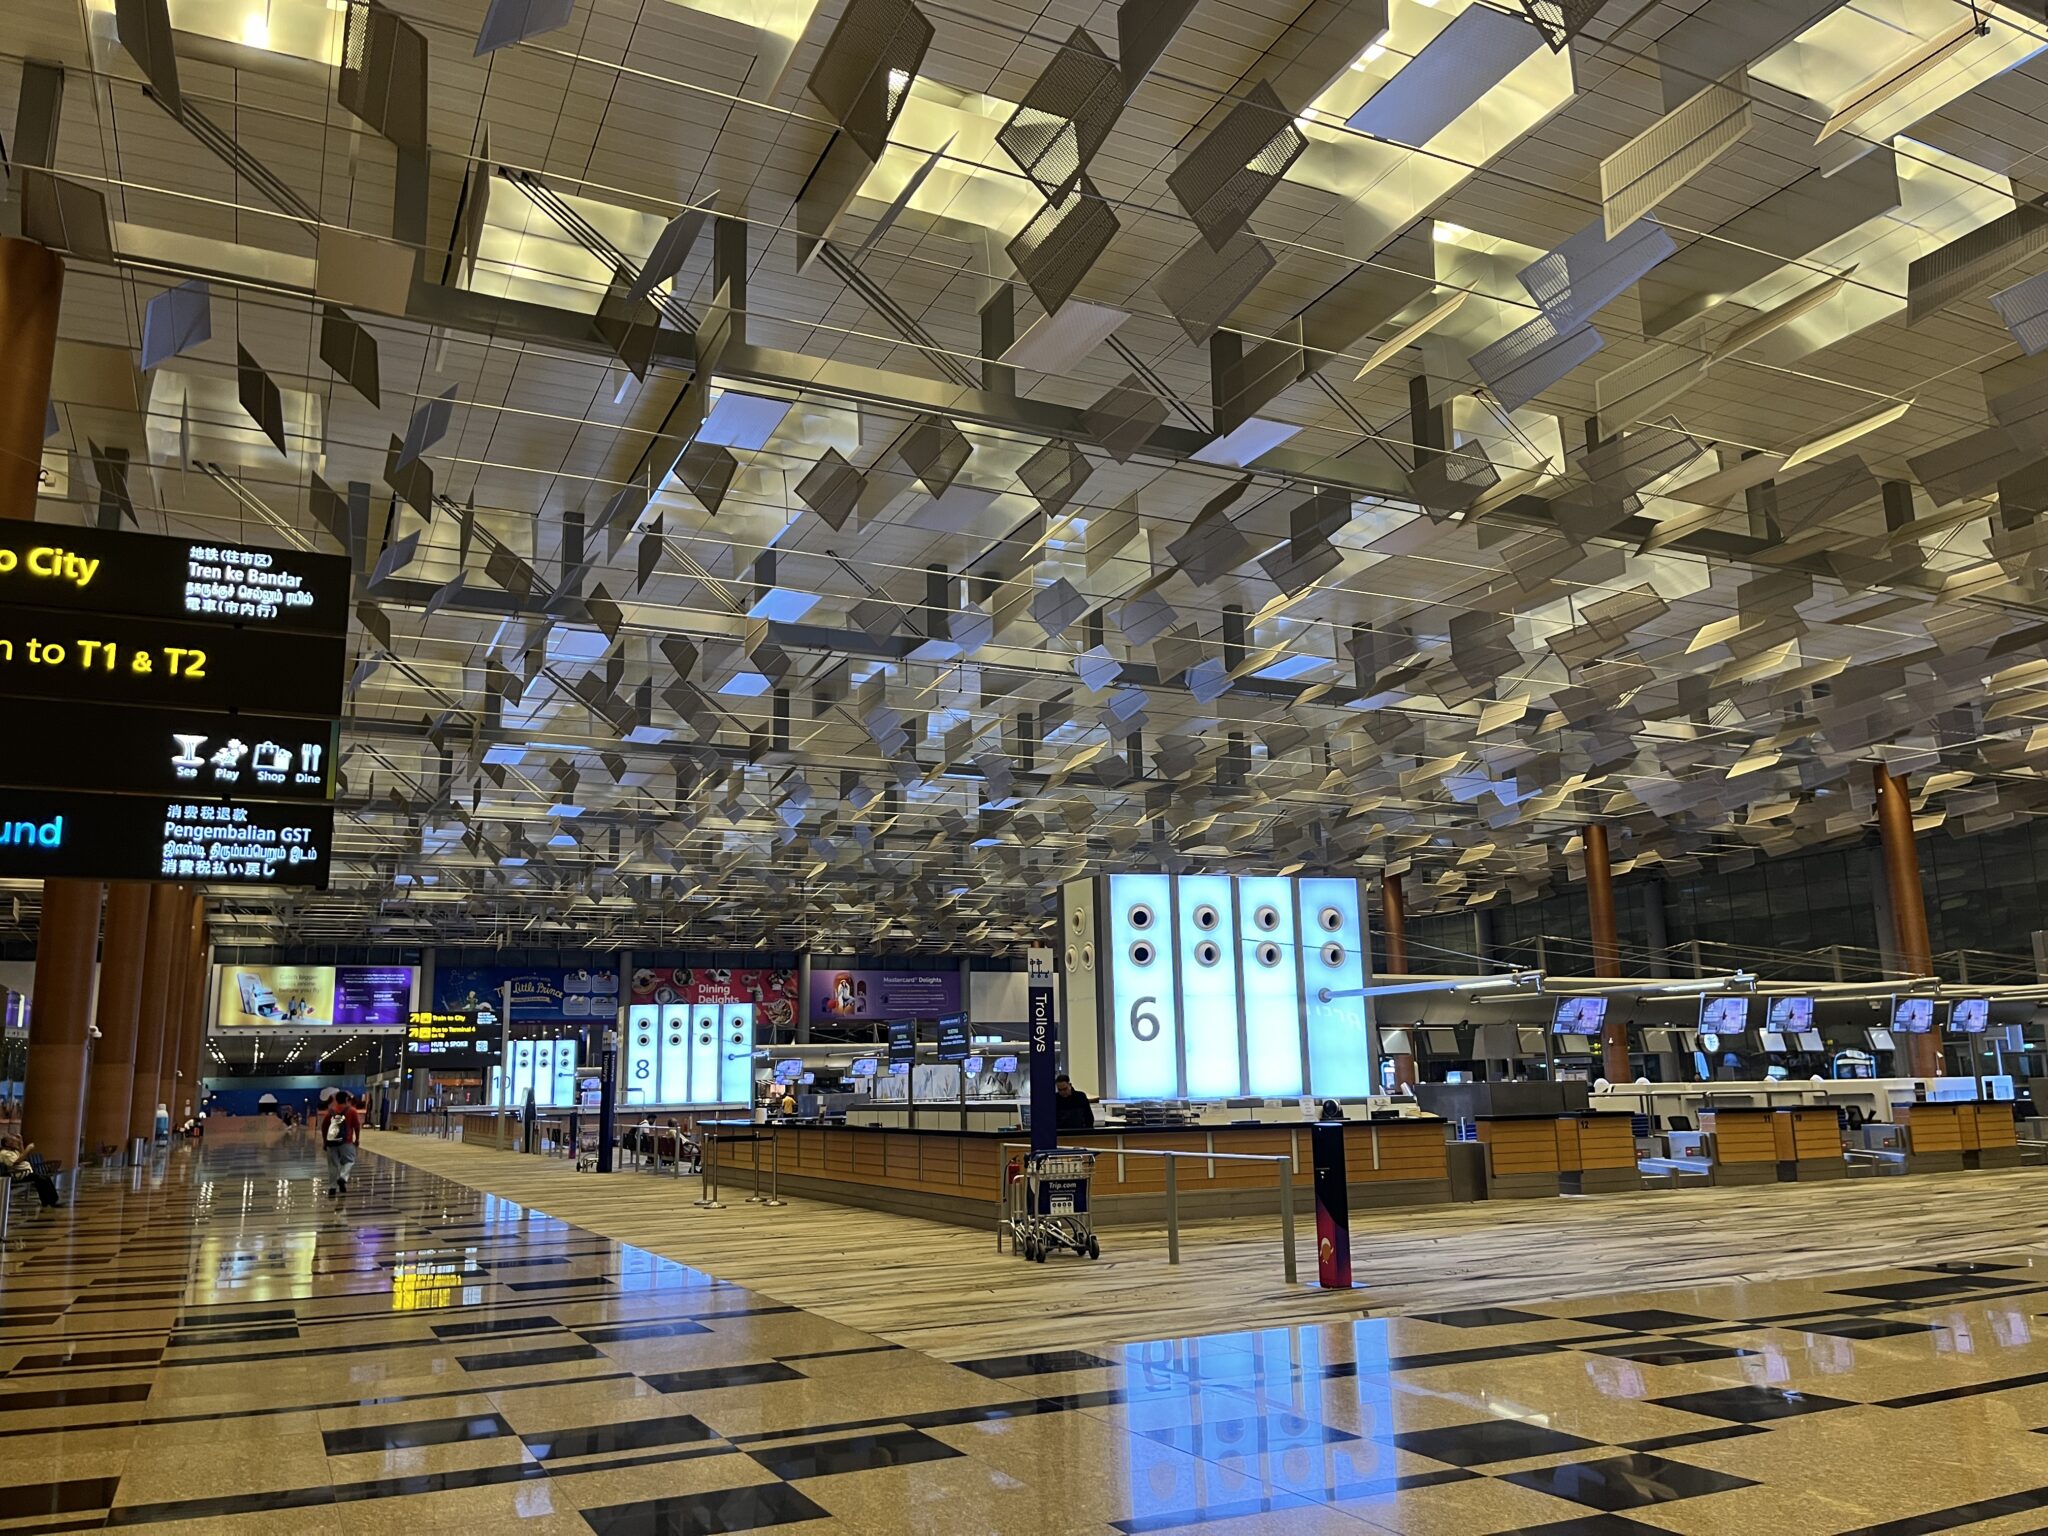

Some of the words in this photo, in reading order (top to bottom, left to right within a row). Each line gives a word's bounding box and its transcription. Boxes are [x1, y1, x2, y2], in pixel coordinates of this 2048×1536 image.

[27, 547, 100, 586] City
[188, 561, 222, 579] Tren
[225, 565, 245, 582] ke
[247, 568, 303, 588] Bandar
[26, 638, 66, 664] to
[77, 639, 117, 670] T1
[132, 651, 152, 672] &
[163, 647, 207, 677] T2
[177, 766, 198, 778] See
[215, 768, 239, 781] Play
[257, 771, 286, 783] Shop
[295, 773, 321, 784] Dine
[167, 804, 249, 822] 消费税退款
[164, 822, 276, 842] Pengembalian
[280, 827, 312, 843] GST
[161, 859, 276, 877] 消費税払い戻し
[698, 984, 730, 996] Dining
[698, 995, 740, 1005] Delights
[1033, 993, 1048, 1053] Trolleys
[1130, 995, 1160, 1042] 6
[635, 1059, 650, 1079] 8
[1048, 1182, 1077, 1190] Trip.com
